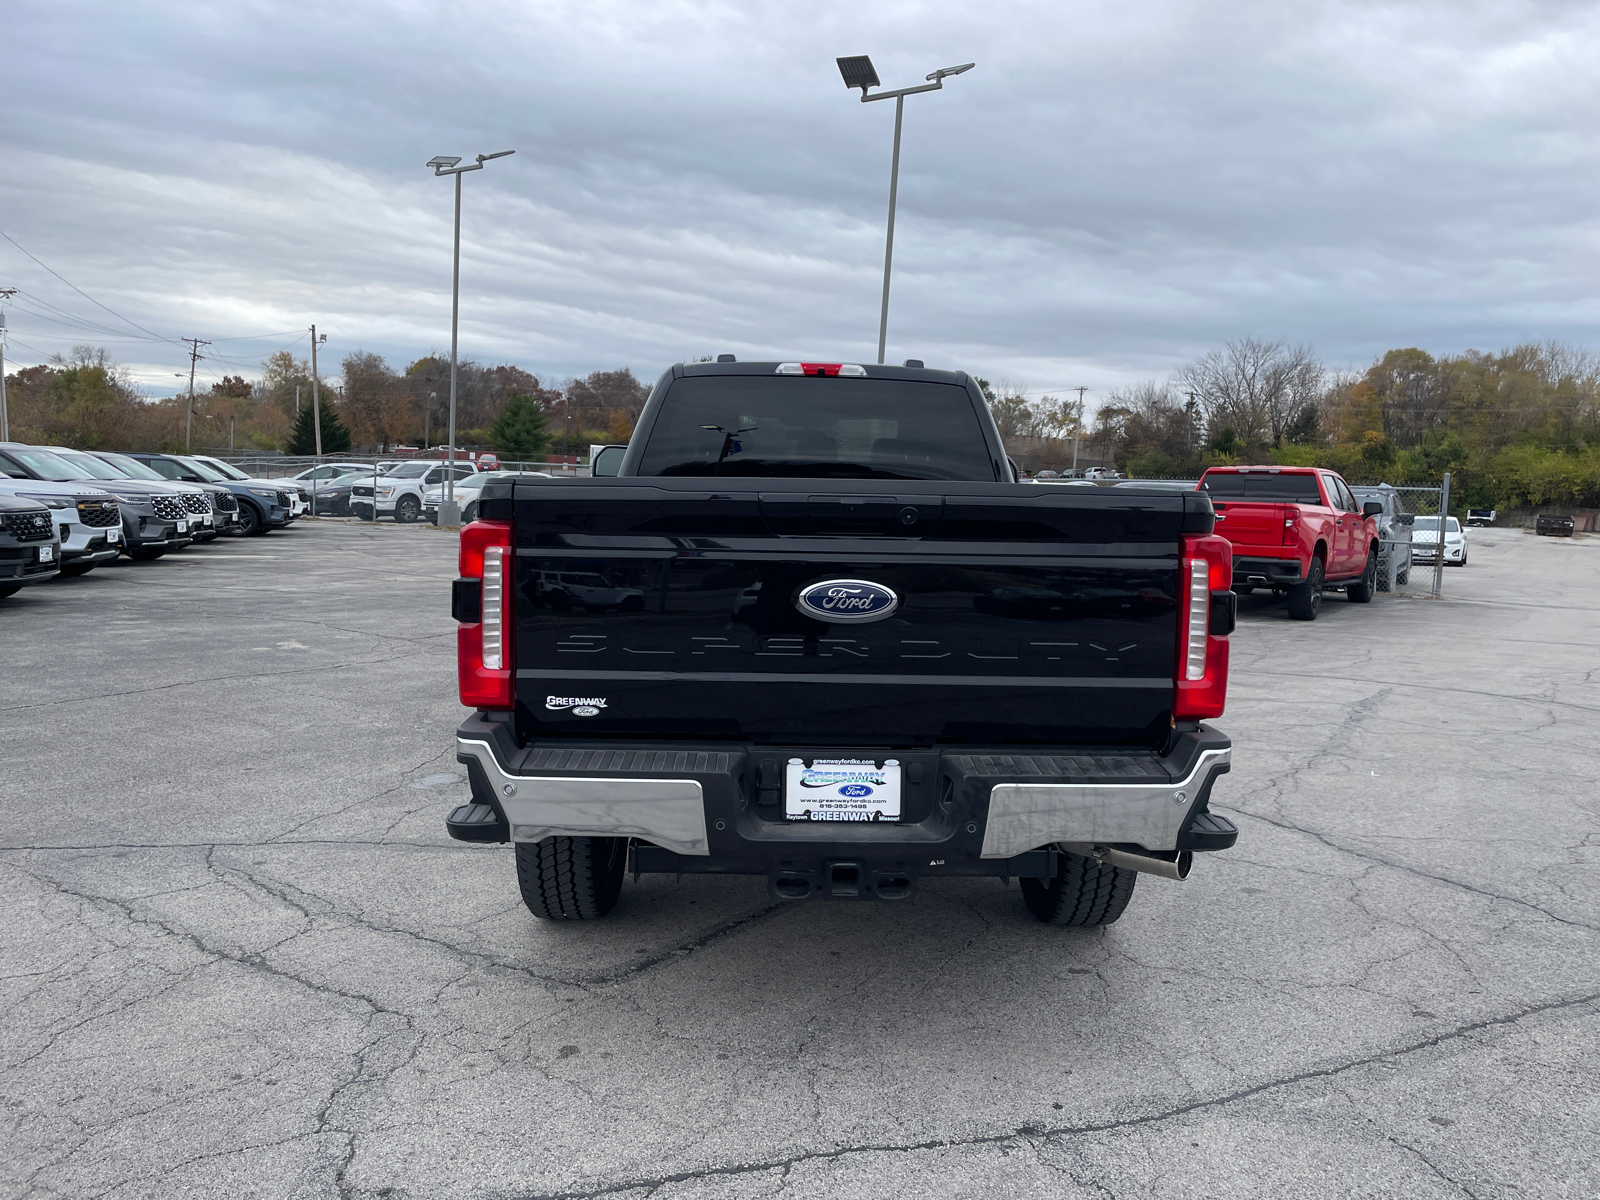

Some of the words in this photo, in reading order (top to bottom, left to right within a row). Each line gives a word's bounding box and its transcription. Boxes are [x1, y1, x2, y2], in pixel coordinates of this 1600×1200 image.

[822, 587, 875, 609] Ford
[556, 634, 869, 657] SUPER
[900, 640, 1137, 661] DUTY
[546, 695, 607, 706] GREENWAY
[802, 769, 886, 782] GREENWAY
[845, 786, 866, 795] Ford
[811, 811, 876, 821] GREENWAY
